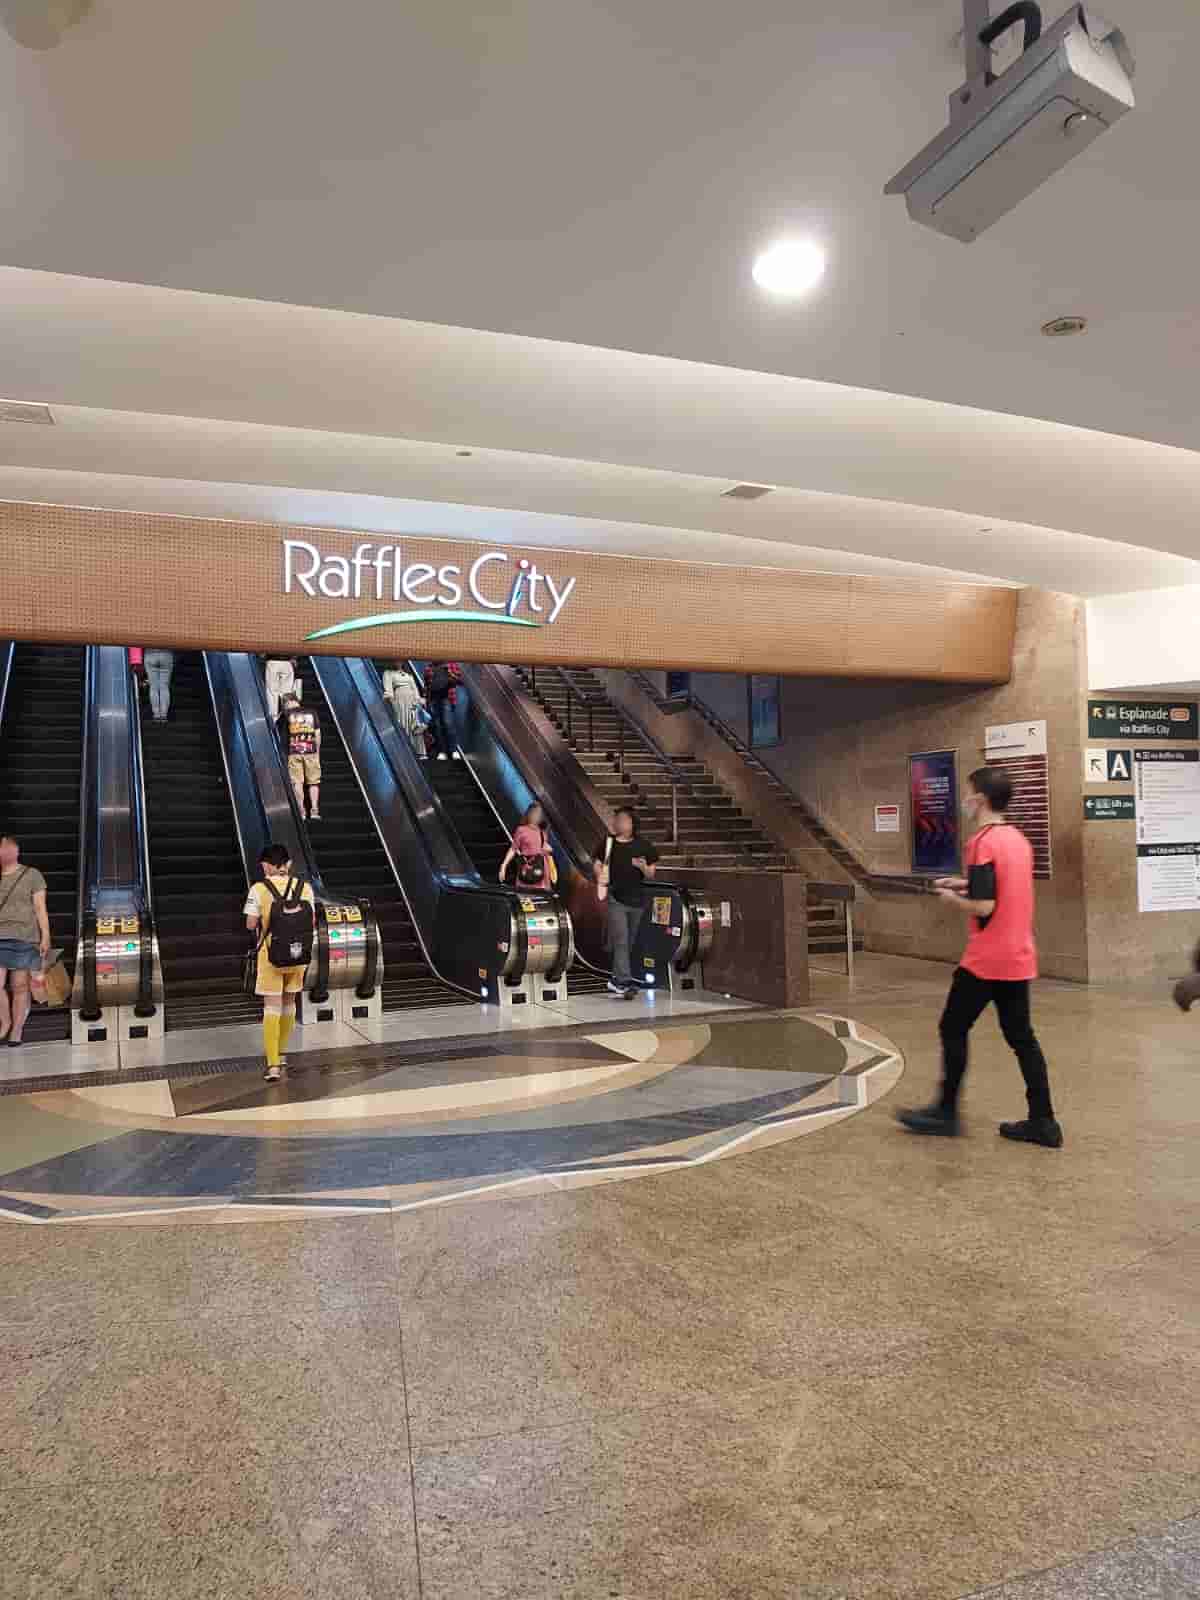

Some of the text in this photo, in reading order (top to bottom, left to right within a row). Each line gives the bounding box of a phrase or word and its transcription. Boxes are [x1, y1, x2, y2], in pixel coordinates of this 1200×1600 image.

[283, 539, 576, 624] Raffles City
[1119, 706, 1169, 721] Esplanade
[1111, 753, 1129, 778] A
